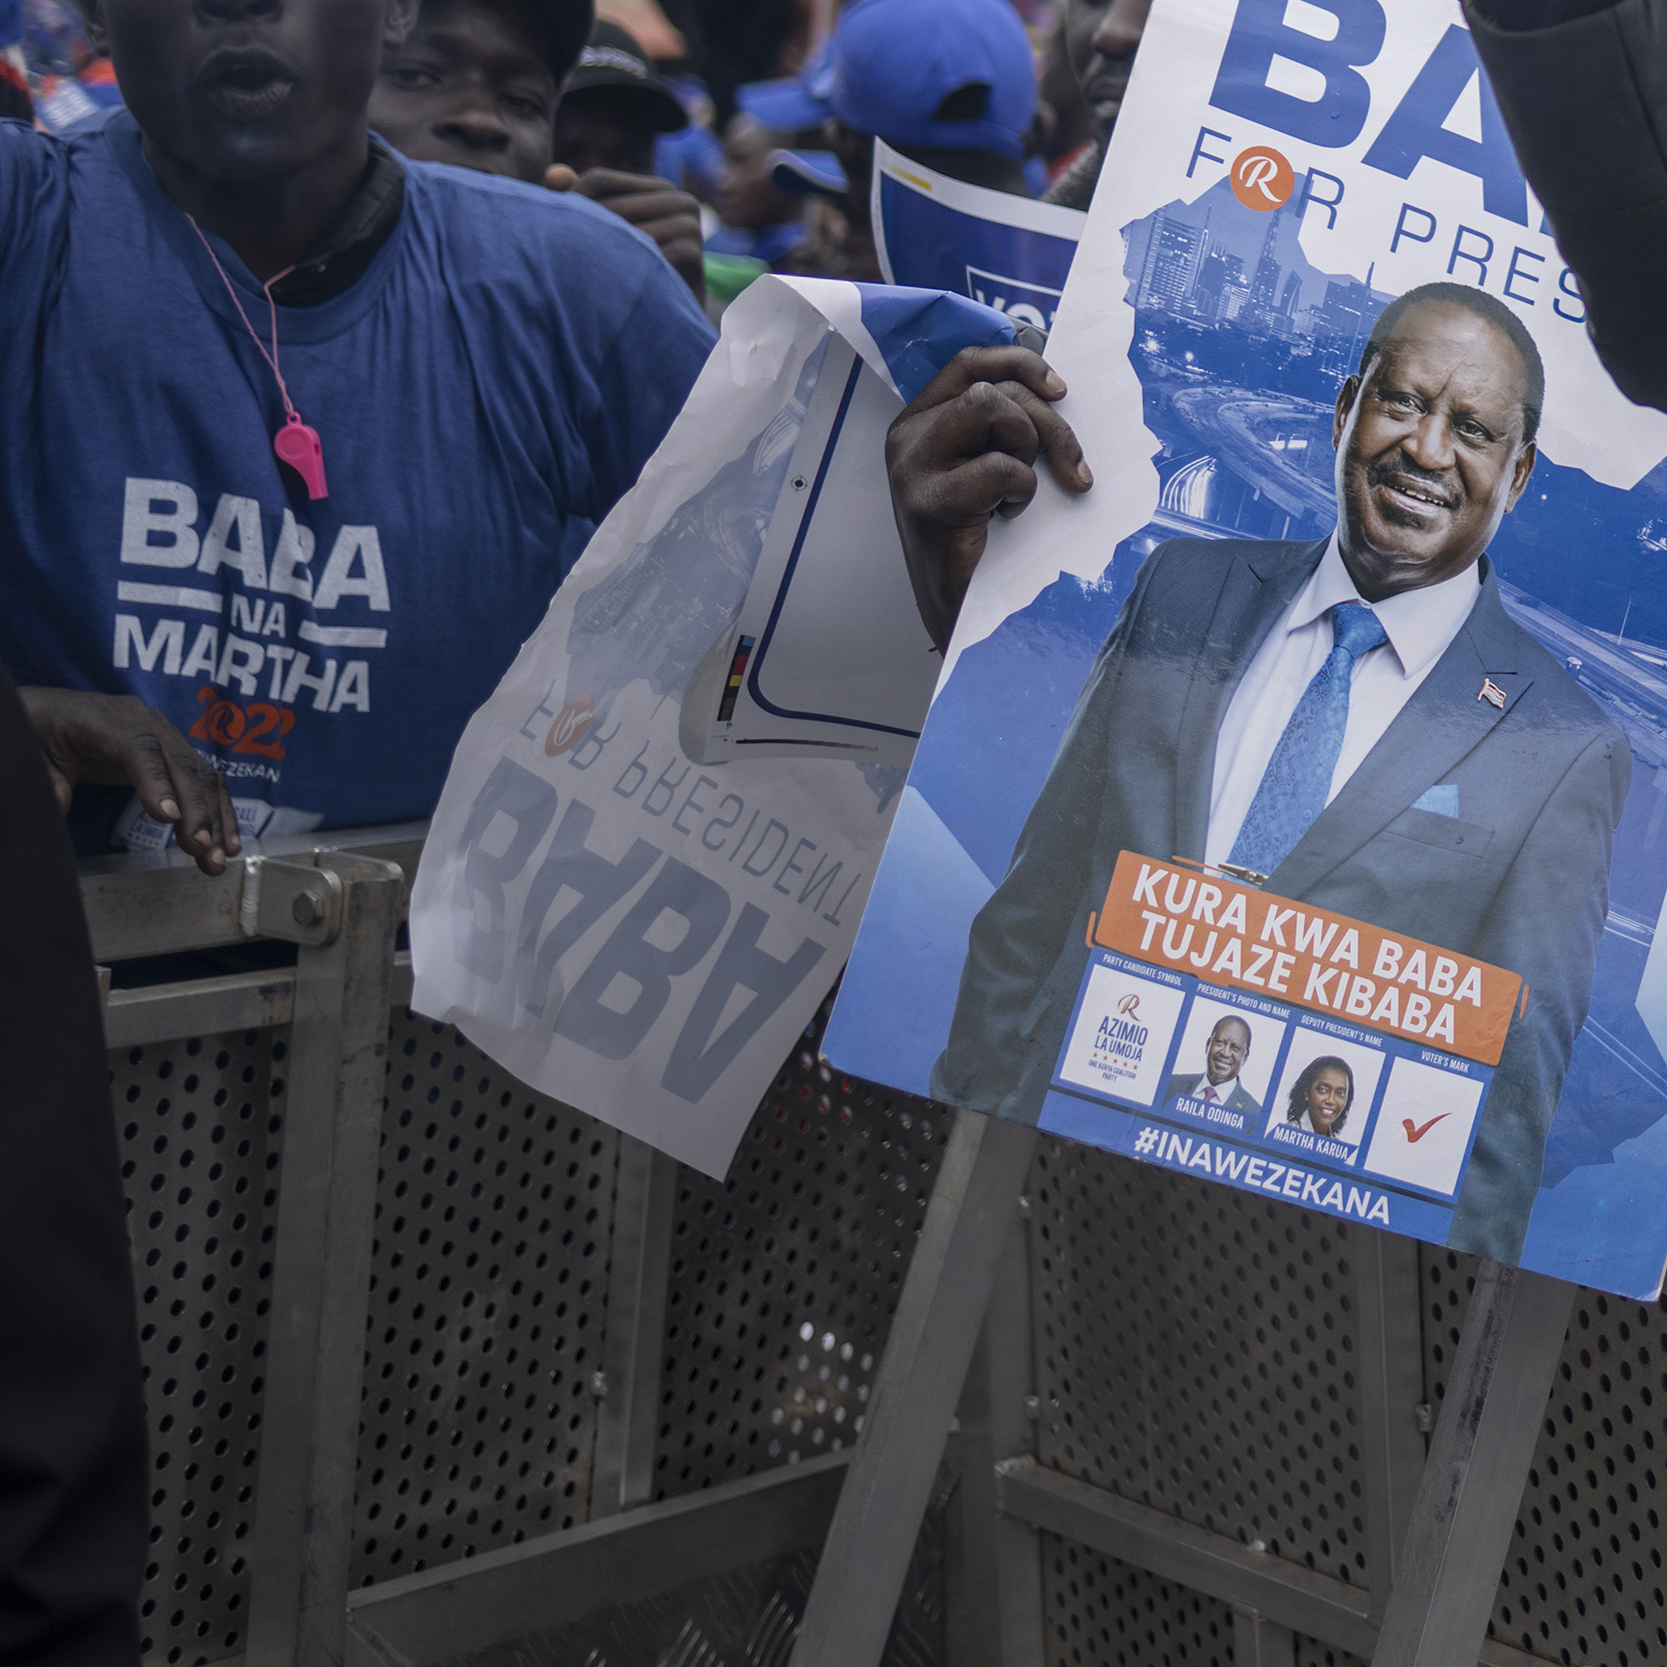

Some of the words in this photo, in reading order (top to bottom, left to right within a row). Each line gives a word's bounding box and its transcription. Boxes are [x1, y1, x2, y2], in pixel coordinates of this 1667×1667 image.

[1389, 201, 1588, 324] PRES
[120, 476, 391, 612] BABA
[230, 592, 286, 638] NA
[113, 613, 370, 712] MARTHA
[1132, 863, 1249, 936] KURA
[1260, 903, 1360, 970] KWA
[1372, 937, 1482, 1008] BABA
[1102, 953, 1123, 967] PARTY
[1122, 959, 1156, 979] CANDIDATE
[1156, 970, 1183, 987] SYMBOL
[1139, 908, 1297, 994] TUJAZE
[1302, 962, 1456, 1046] KIBABA
[1197, 982, 1238, 1003] PRESIDENT'S
[1237, 994, 1258, 1009] PHOTO
[1257, 1001, 1272, 1013] AND
[1271, 1005, 1291, 1019] NAME
[1094, 1034, 1109, 1052] LA
[1108, 1038, 1144, 1062] UMOJA
[1098, 1014, 1149, 1047] AZIMIO
[1301, 1014, 1326, 1030] DEPUTY
[1325, 1021, 1365, 1042] PRESIDENT'S
[1364, 1033, 1383, 1047] NAME
[1101, 1071, 1119, 1083] PARTY
[1113, 1065, 1138, 1081] COALITION
[1421, 1050, 1450, 1068] VOTER'S
[1449, 1058, 1471, 1073] MARK
[1175, 1096, 1206, 1119] RAILA
[1206, 1107, 1246, 1130] ODINGA
[1272, 1125, 1316, 1150] MARTHA
[1315, 1138, 1350, 1161] KARUA
[1133, 1126, 1391, 1225] #INAWEZEKANA
